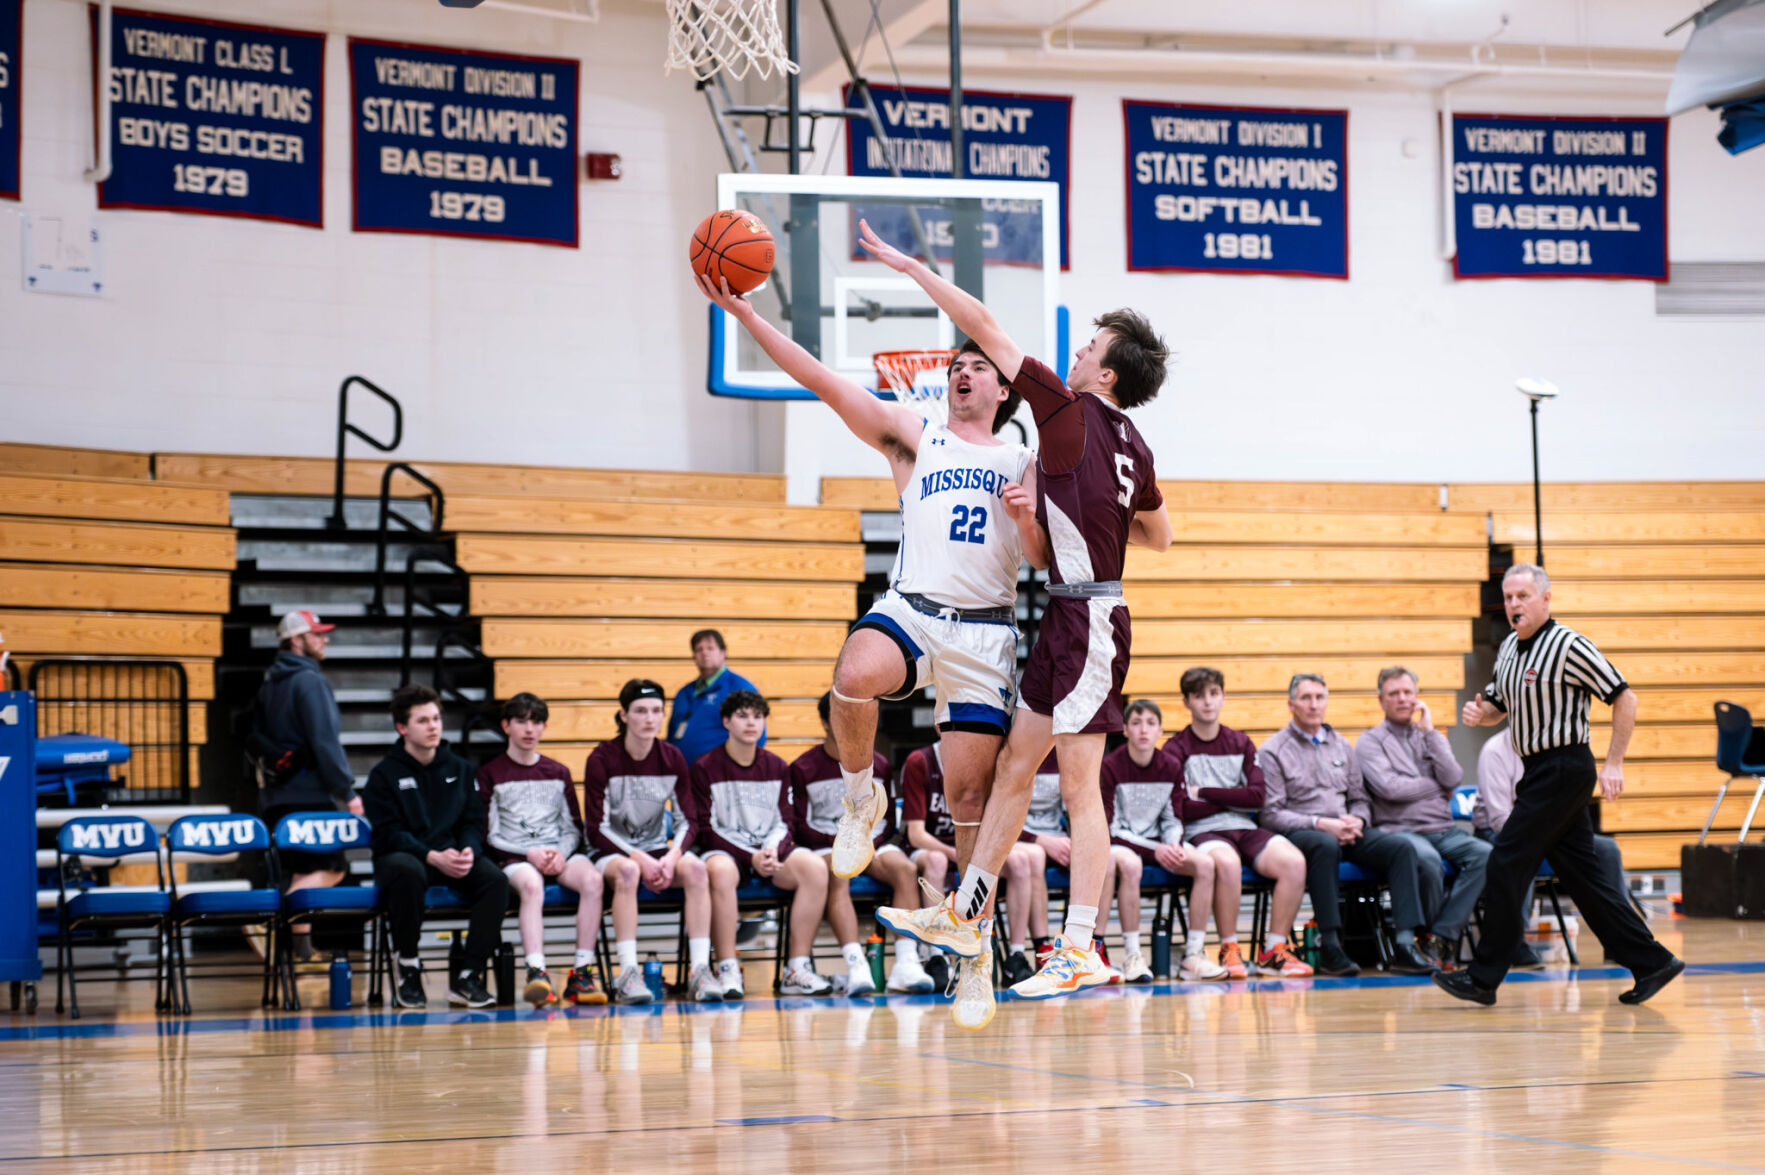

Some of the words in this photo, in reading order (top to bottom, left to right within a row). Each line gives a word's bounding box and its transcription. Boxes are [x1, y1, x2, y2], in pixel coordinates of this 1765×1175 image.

[123, 27, 207, 64] VERMONT
[214, 40, 274, 71] CLASS
[109, 66, 178, 109] STATE
[186, 75, 313, 125] CHAMPIONS
[374, 57, 457, 91] VERMONT
[464, 66, 536, 99] DIVISION
[541, 74, 556, 101] II
[362, 97, 435, 137] STATE
[441, 105, 568, 149] CHAMPIONS
[1151, 116, 1231, 145] VERMONT
[1238, 120, 1309, 148] DIVISION
[118, 117, 190, 151] BOYS
[197, 125, 304, 164] SOCCER
[1465, 127, 1547, 155] VERMONT
[1553, 130, 1626, 156] DIVISION
[1632, 131, 1647, 156] II
[380, 146, 552, 187] BASEBALL
[969, 142, 1050, 179] CHAMPIONS
[1135, 151, 1208, 186] STATE
[1214, 154, 1338, 192] CHAMPIONS
[173, 164, 249, 197] 1979
[1454, 162, 1523, 195] STATE
[1530, 163, 1658, 198] CHAMPIONS
[429, 190, 505, 223] 1979
[1155, 194, 1322, 226] SOFTBALL
[1472, 203, 1641, 232] BASEBALL
[1203, 233, 1273, 260] 1981
[1522, 239, 1592, 265] 1981
[1114, 452, 1135, 509] 5
[949, 504, 988, 545] 22
[71, 822, 147, 849] MVU
[180, 819, 256, 847] MVU
[287, 818, 360, 845] MVU
